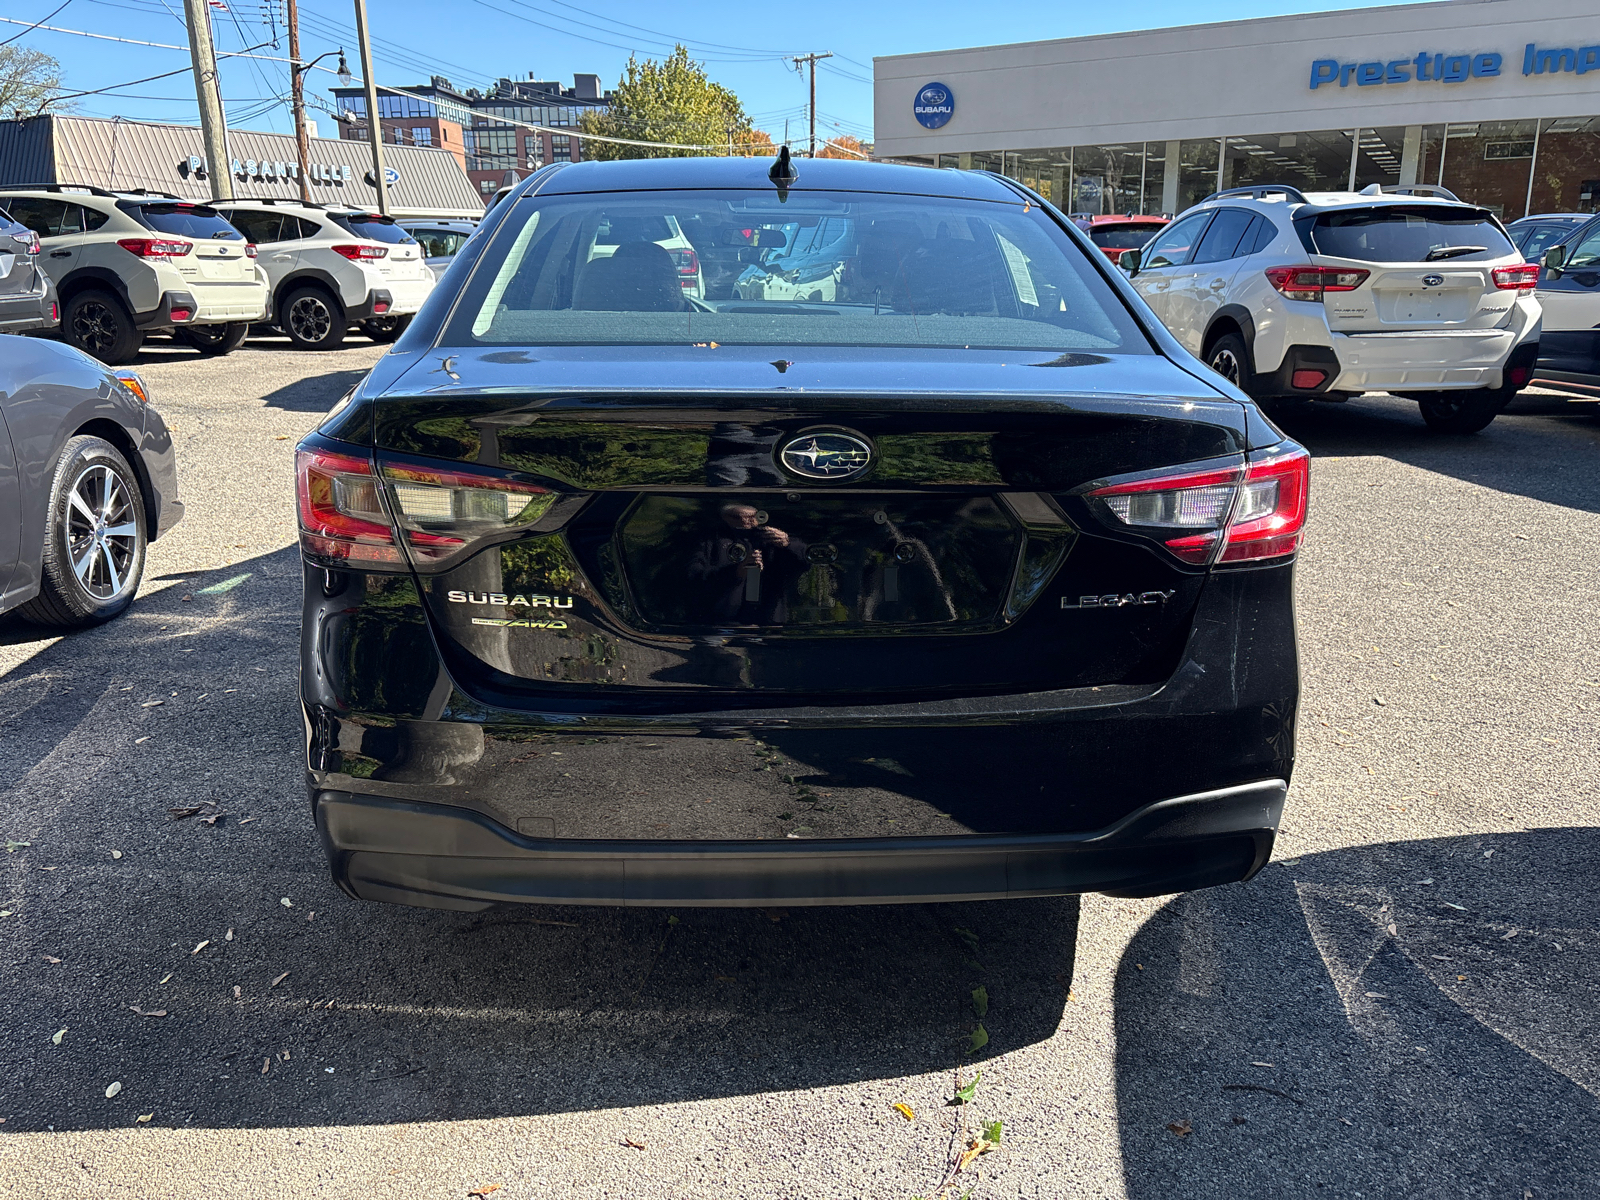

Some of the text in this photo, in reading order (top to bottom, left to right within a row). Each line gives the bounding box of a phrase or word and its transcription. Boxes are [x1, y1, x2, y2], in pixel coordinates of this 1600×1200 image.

[1309, 43, 1600, 90] Prestige Imp
[189, 155, 352, 181] PASANTILLE
[447, 590, 573, 609] SUBARU
[1061, 589, 1176, 609] LEGACY
[507, 618, 568, 629] AWD
